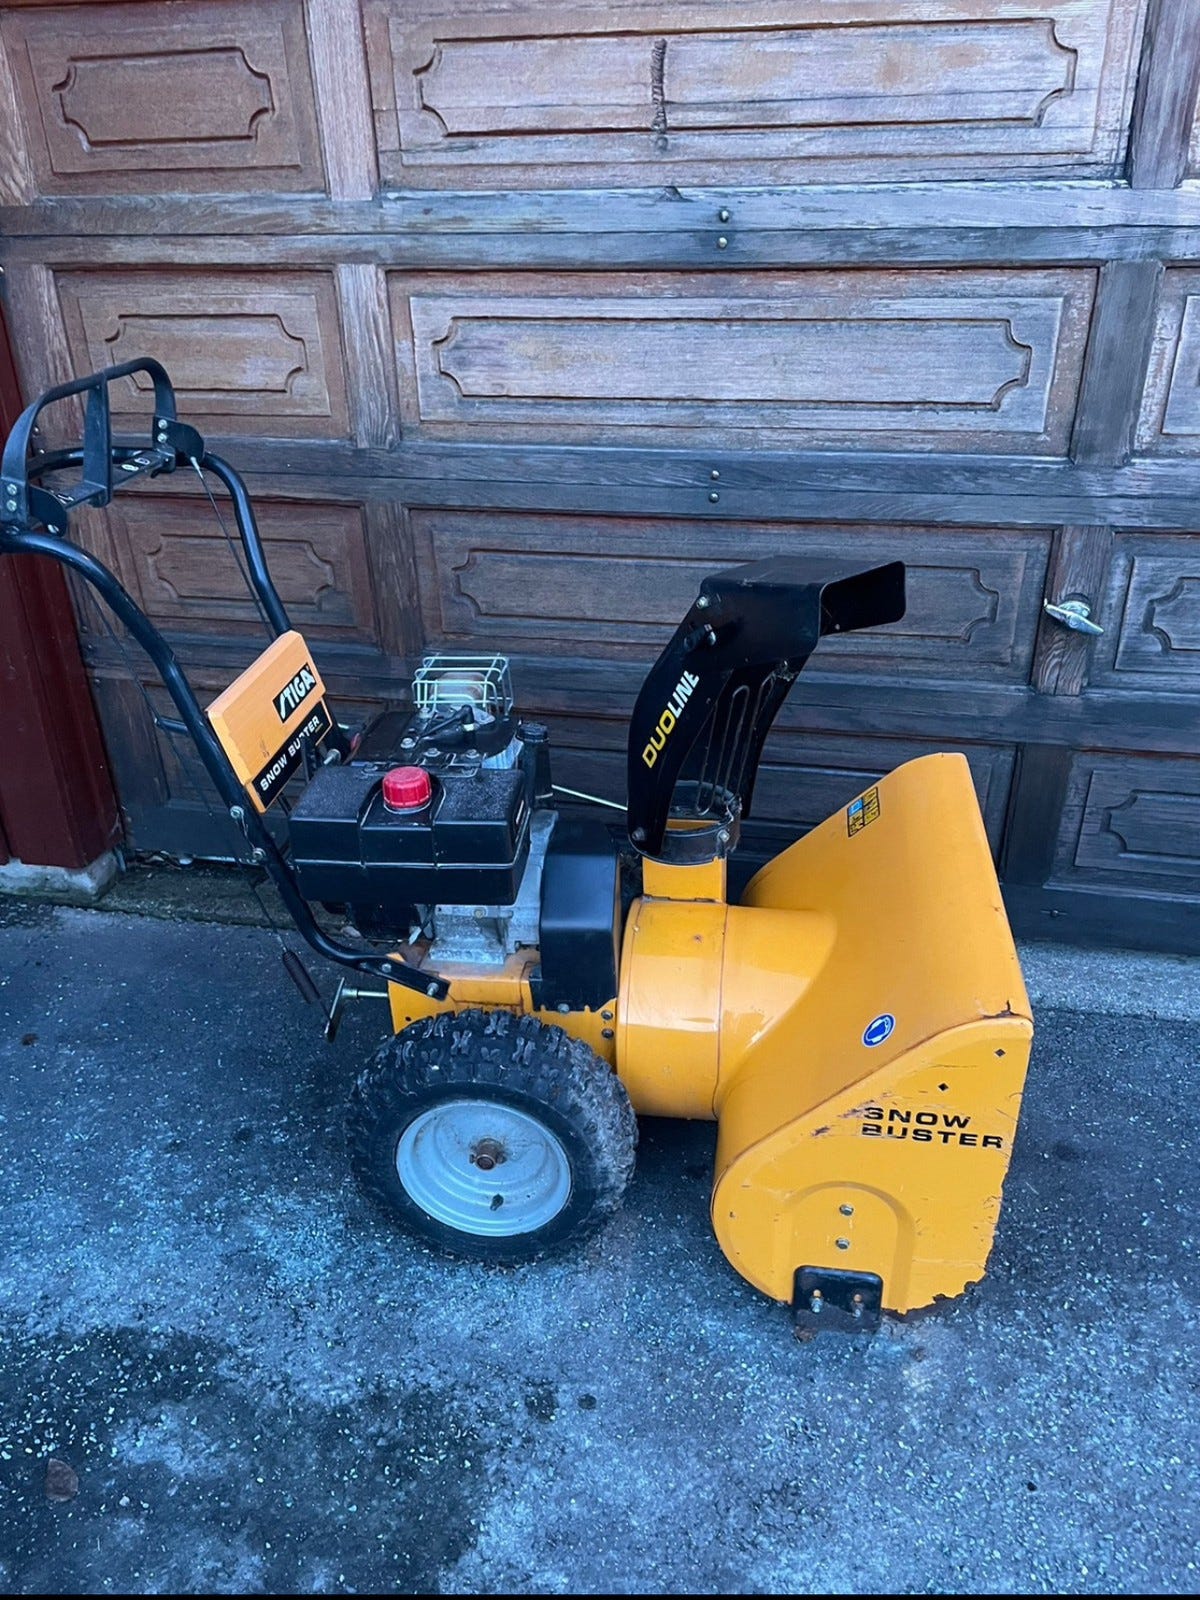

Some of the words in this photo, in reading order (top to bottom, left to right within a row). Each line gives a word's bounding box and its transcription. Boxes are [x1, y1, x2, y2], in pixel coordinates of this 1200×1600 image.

[280, 669, 316, 720] STIGA
[642, 670, 700, 769] DUOLINE
[259, 754, 288, 791] SNOW
[861, 1122, 1004, 1149] BUSTER
[864, 1106, 971, 1129] SNOW
